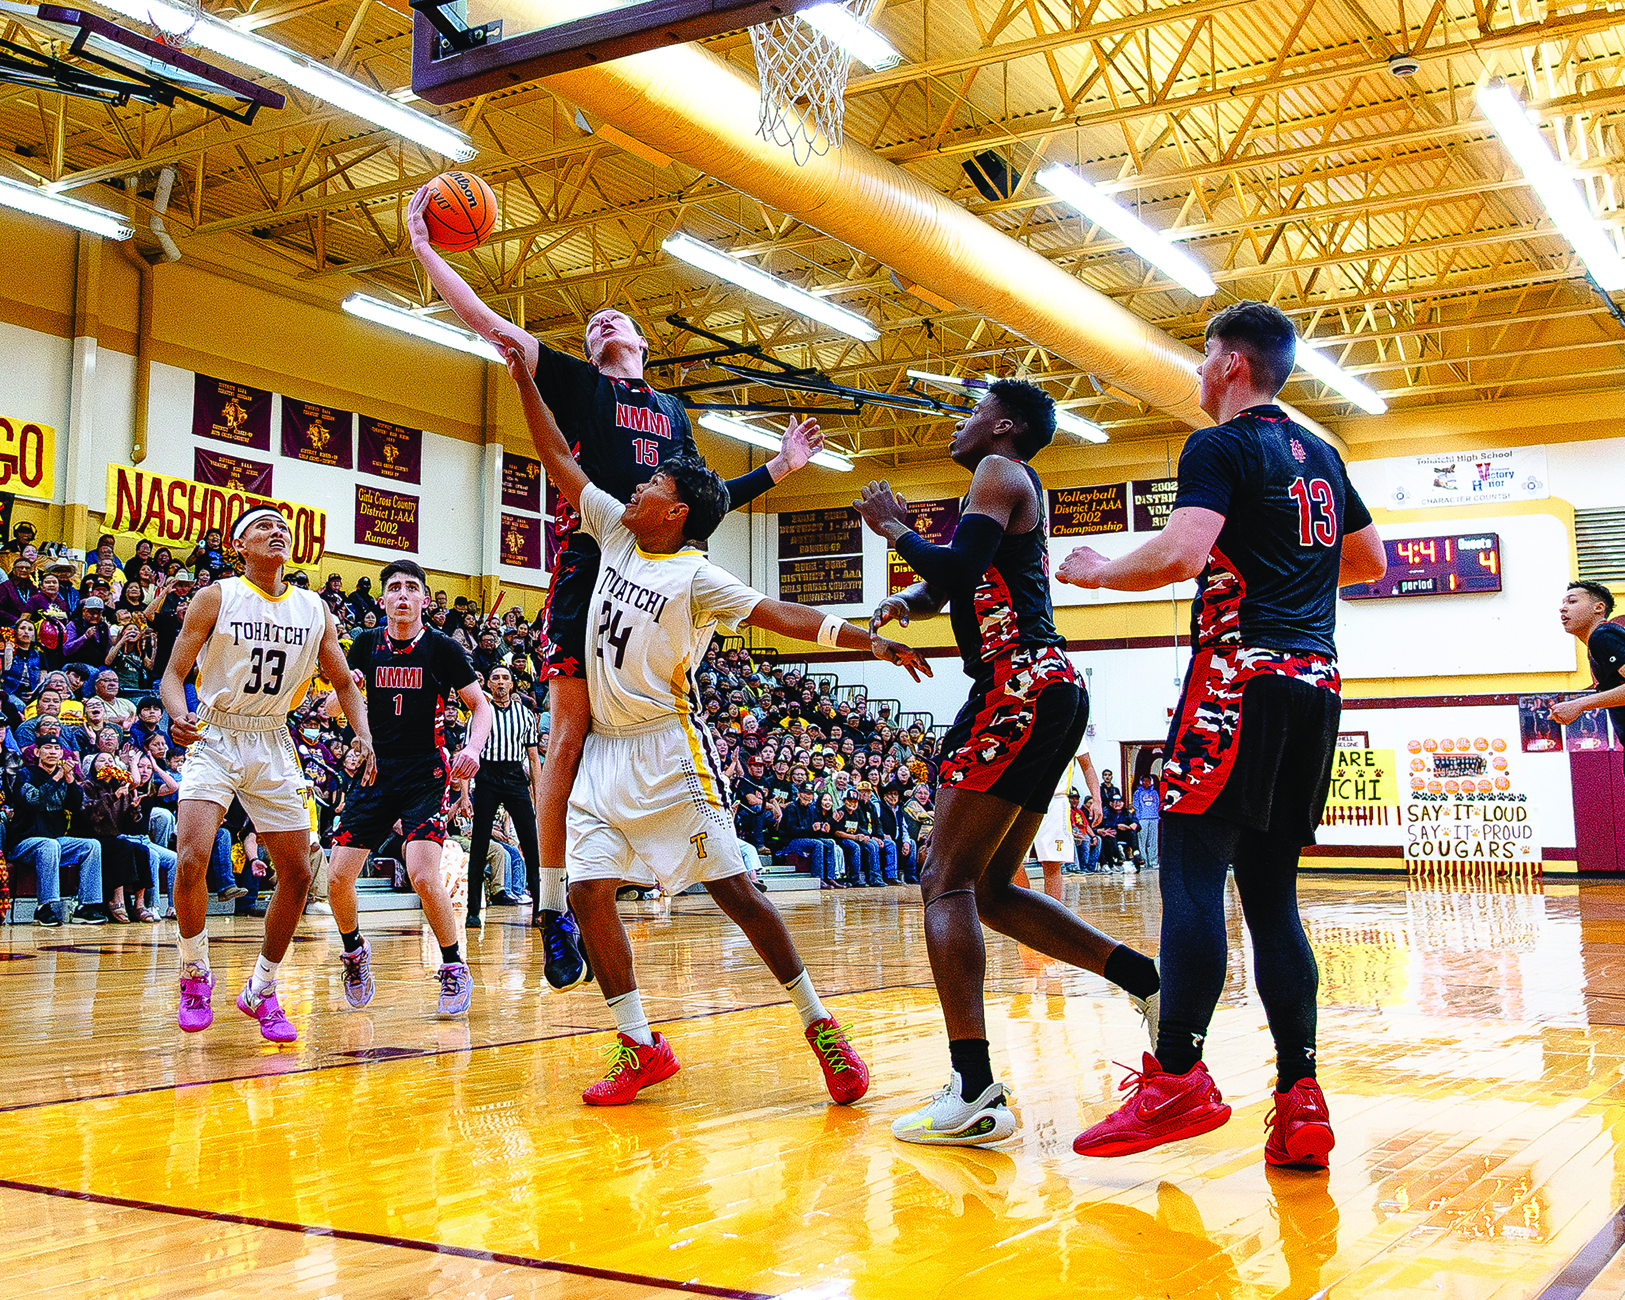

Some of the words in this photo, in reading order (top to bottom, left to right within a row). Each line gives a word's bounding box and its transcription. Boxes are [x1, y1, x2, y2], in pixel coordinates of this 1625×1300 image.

[616, 402, 671, 440] NMMI
[632, 438, 658, 467] 15
[1457, 454, 1478, 463] High
[1481, 450, 1513, 459] School
[1057, 488, 1117, 502] Volleyball
[1151, 481, 1179, 492] 2002
[358, 488, 373, 503] Girls
[374, 491, 391, 507] Cross
[392, 495, 417, 514] Country
[360, 502, 388, 519] District
[1054, 503, 1088, 515] District
[1092, 499, 1122, 511] 1-AAA
[1072, 511, 1101, 524] 2002
[1288, 476, 1337, 547] 13
[374, 519, 398, 535] 2002
[1052, 521, 1123, 535] Championship
[364, 530, 410, 550] Runner-Up
[1478, 551, 1497, 574] 4
[1401, 578, 1433, 593] period
[1449, 573, 1456, 590] 1
[230, 621, 310, 646] TOHATCHI
[597, 600, 633, 670] 24
[243, 647, 287, 696] 33
[375, 666, 423, 690] NMMI
[391, 693, 402, 716] 1
[1338, 751, 1375, 767] ARE
[1331, 779, 1381, 800] TCHI
[1407, 804, 1443, 822] SAY
[1453, 803, 1474, 821] IT
[1483, 805, 1527, 822] LOUD
[1408, 824, 1441, 842] SAY
[1453, 824, 1472, 840] IT
[1483, 824, 1532, 841] PROUD
[689, 831, 708, 859] T
[1055, 840, 1064, 851] T
[1408, 840, 1516, 859] COUGARS
